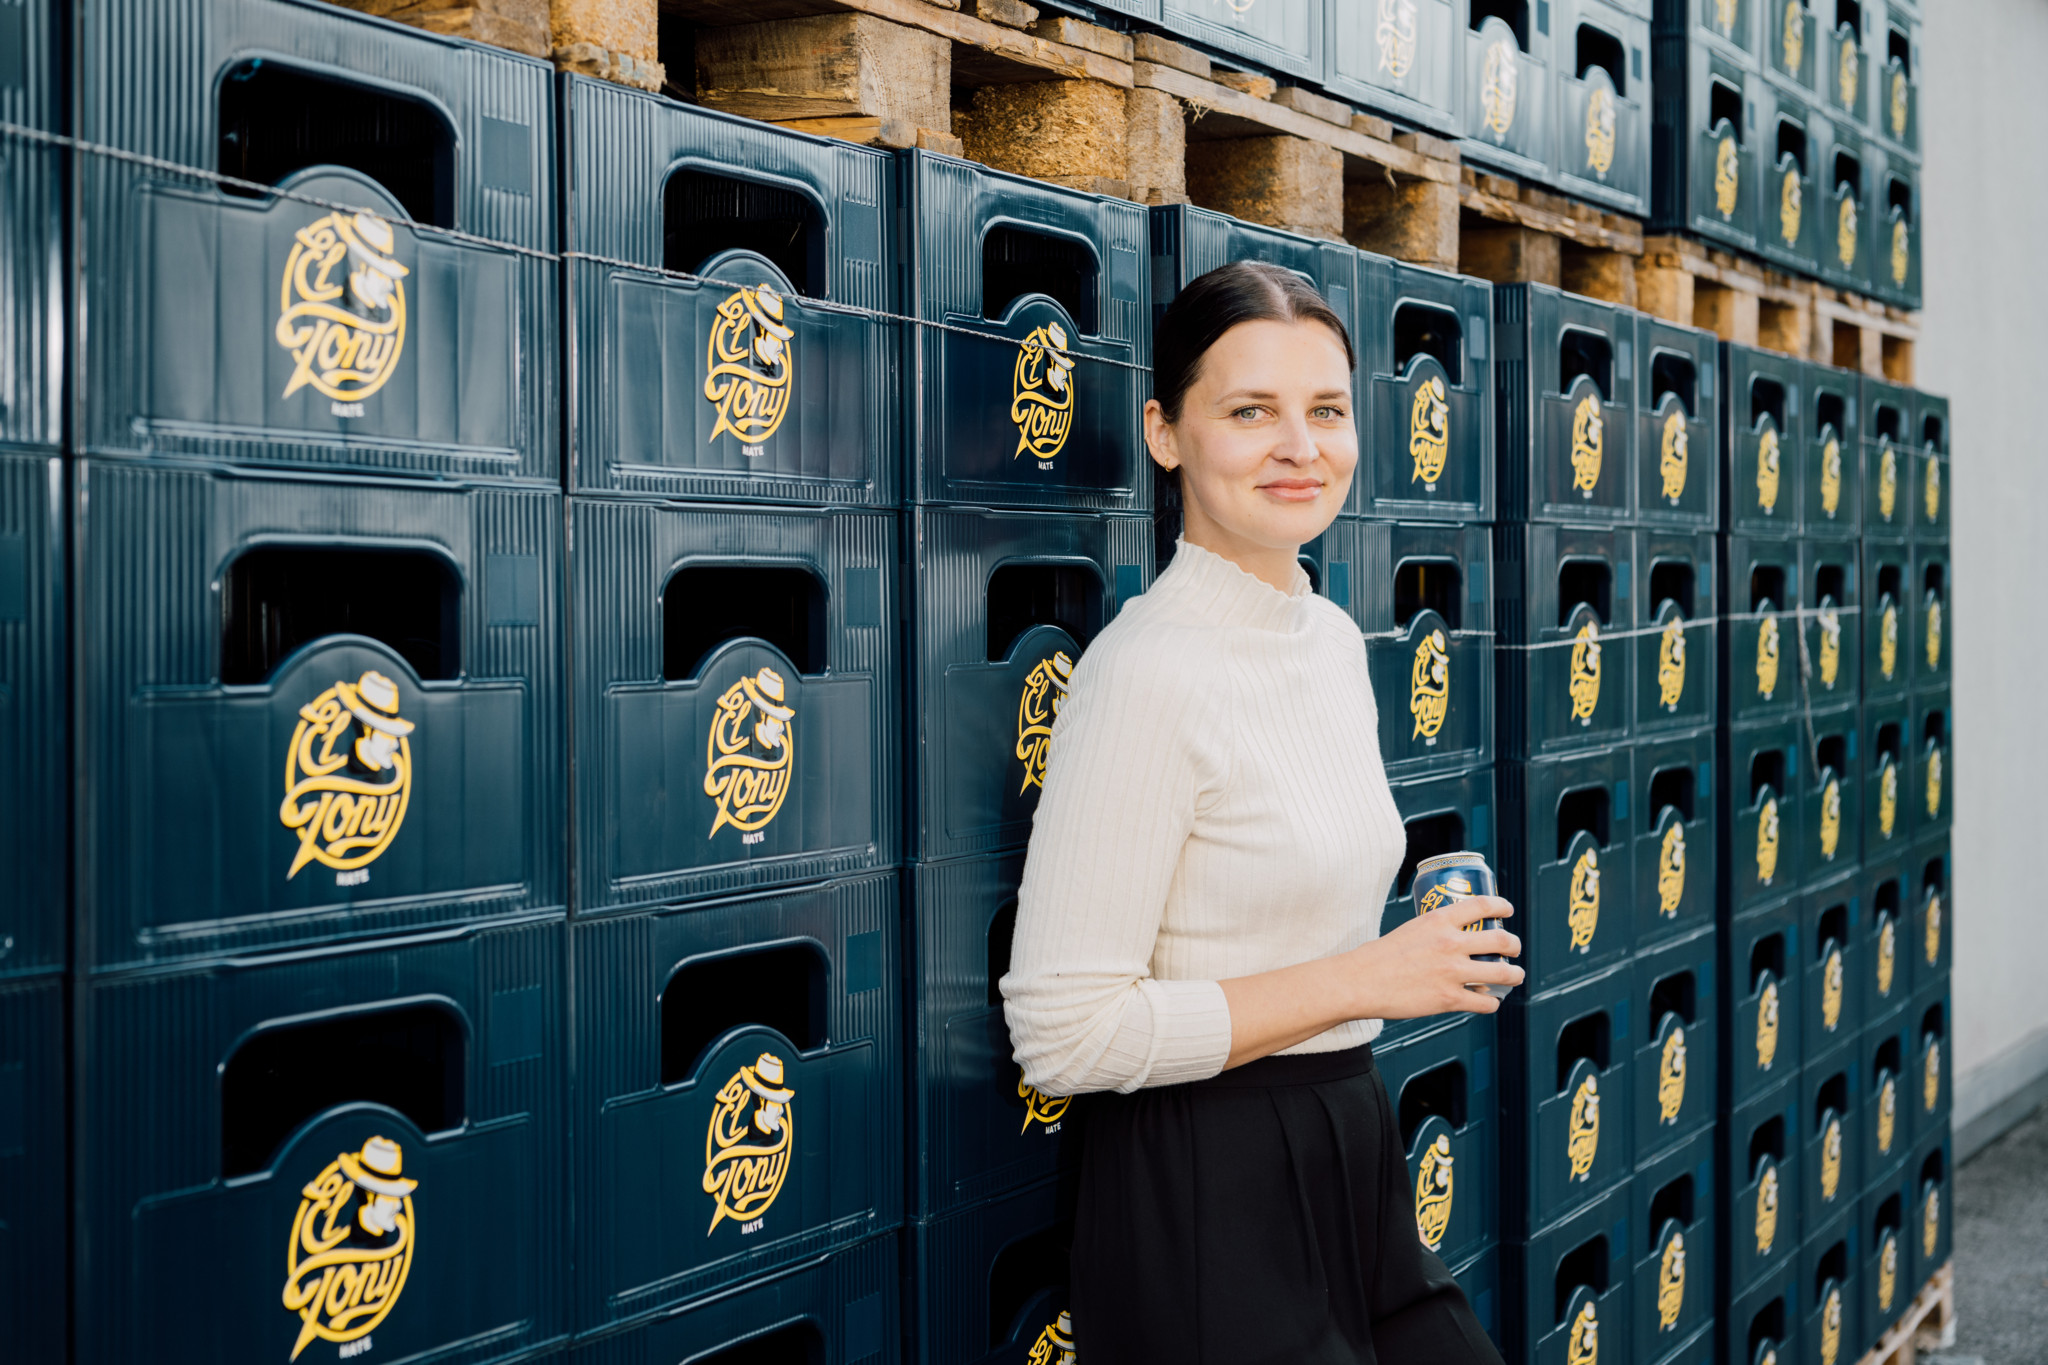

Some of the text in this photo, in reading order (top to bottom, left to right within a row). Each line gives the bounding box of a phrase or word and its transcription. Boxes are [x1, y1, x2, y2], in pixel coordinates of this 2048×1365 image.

[295, 227, 347, 302] El
[276, 293, 399, 400] Tony
[716, 302, 752, 362] El
[704, 353, 788, 444] Tony
[1011, 381, 1071, 460] Tony
[742, 445, 764, 457] MATE
[1038, 460, 1054, 471] MATE
[716, 691, 752, 755] El
[1025, 671, 1049, 725] El
[298, 699, 352, 777] El
[279, 752, 405, 881] Tony
[704, 734, 789, 840] Tony
[742, 830, 765, 845] MATE
[715, 1082, 751, 1149] El
[1045, 1122, 1062, 1135] MATE
[301, 1173, 355, 1255] El
[702, 1116, 789, 1238] Tony
[741, 1217, 764, 1235] MATE
[282, 1213, 409, 1364] Tony
